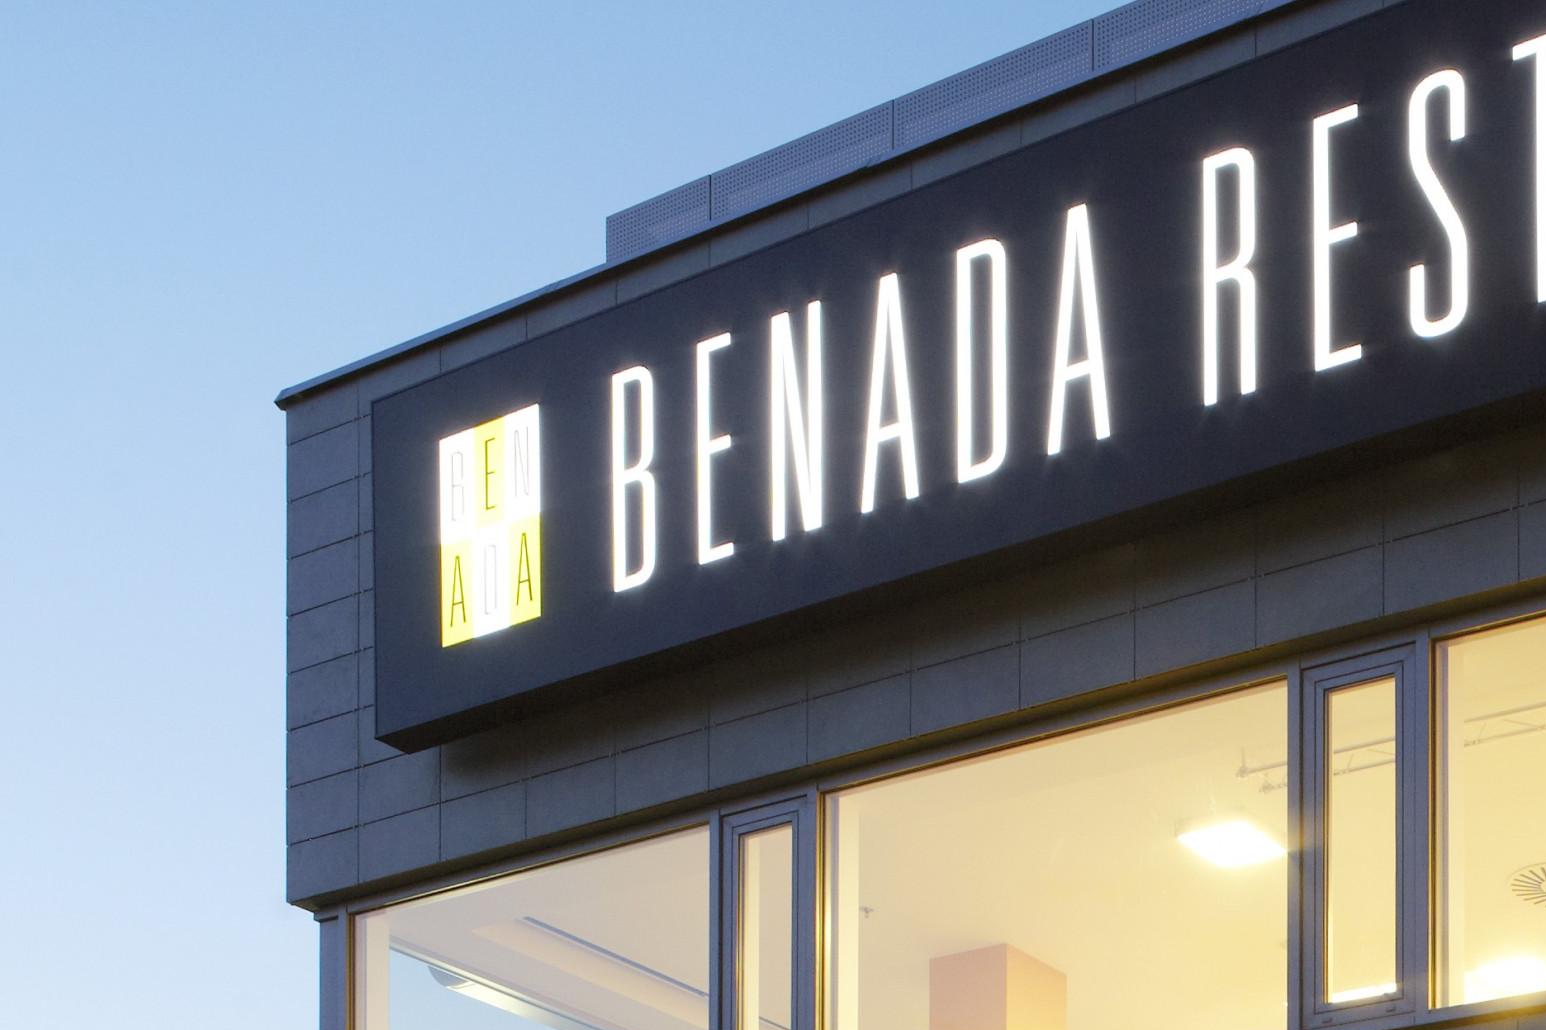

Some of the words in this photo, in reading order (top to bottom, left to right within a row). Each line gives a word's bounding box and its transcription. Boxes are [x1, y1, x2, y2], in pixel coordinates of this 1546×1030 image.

[611, 202, 1112, 594] BENADA
[450, 426, 530, 522] BEN
[450, 532, 534, 628] ADA
